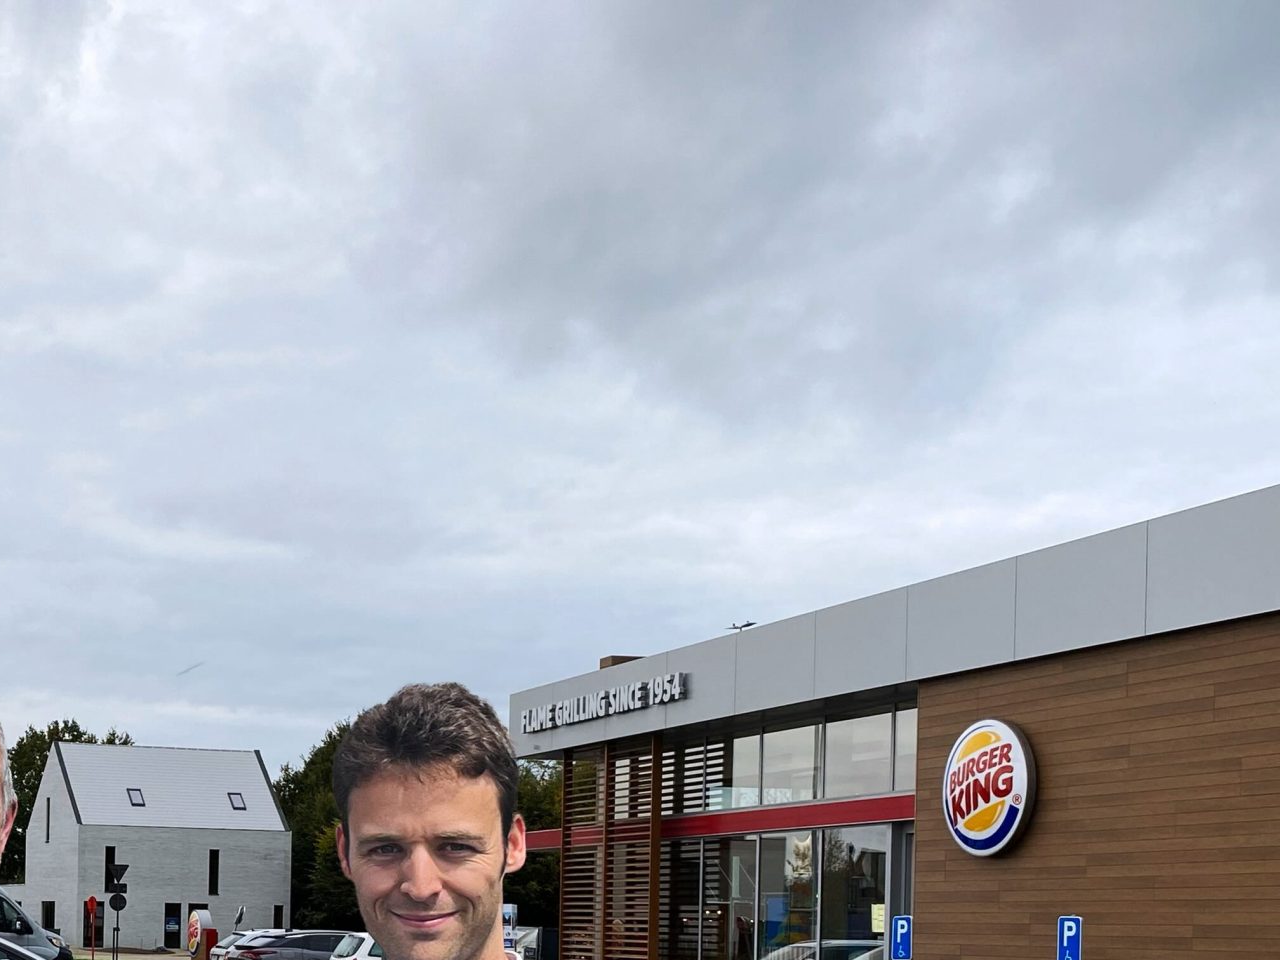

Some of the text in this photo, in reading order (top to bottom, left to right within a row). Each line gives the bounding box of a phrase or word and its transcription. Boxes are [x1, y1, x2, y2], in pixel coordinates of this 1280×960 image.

[520, 671, 682, 734] FLAME GRILLING SINCE 1954
[949, 743, 1012, 796] BURGER
[949, 765, 1014, 829] KING
[896, 919, 908, 943] P
[1063, 920, 1076, 947] P
